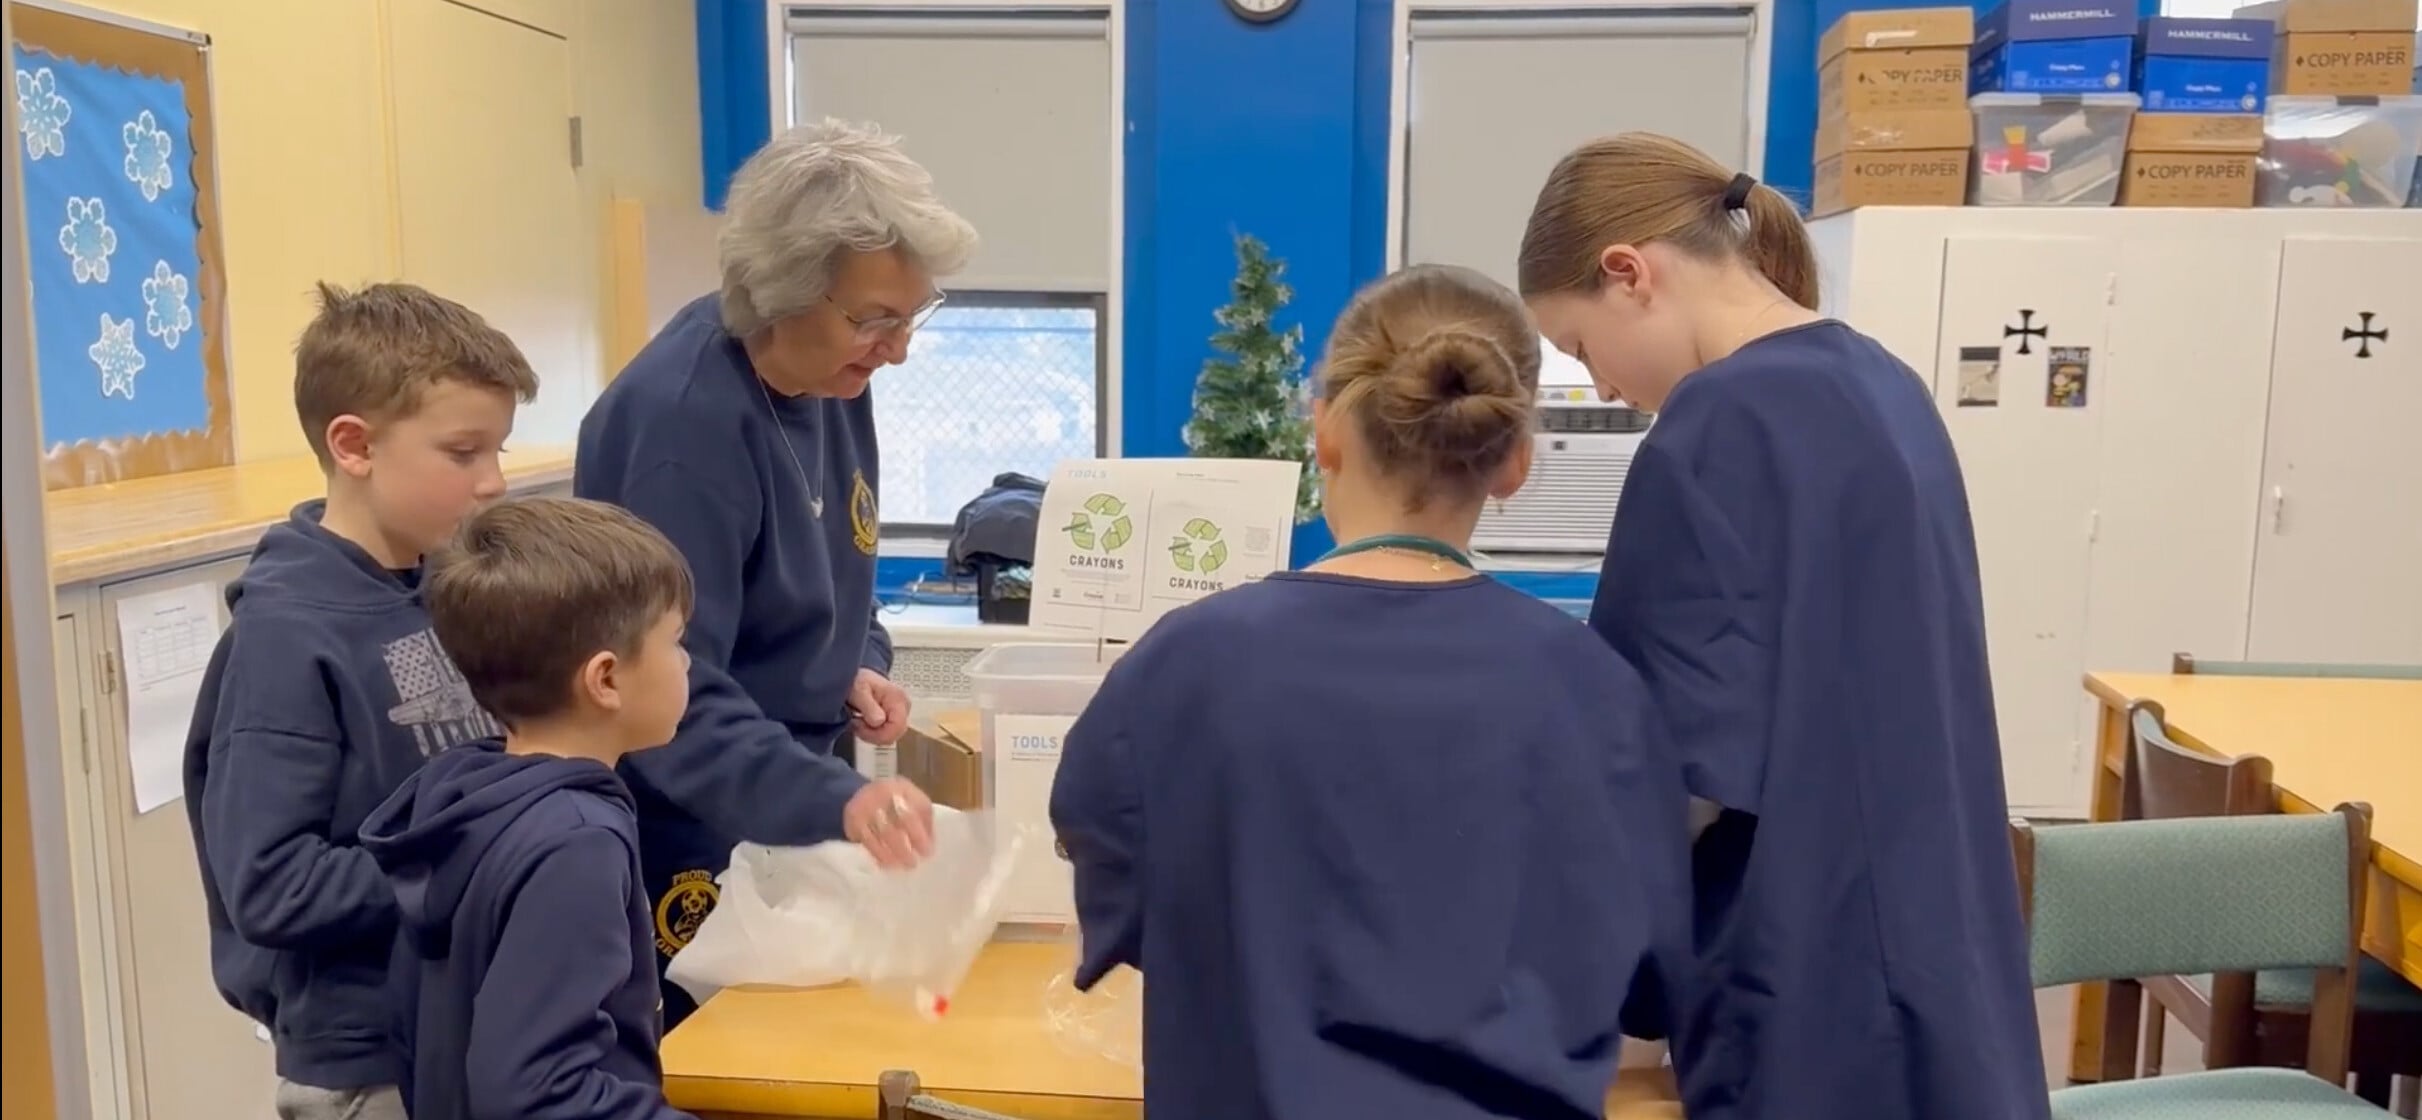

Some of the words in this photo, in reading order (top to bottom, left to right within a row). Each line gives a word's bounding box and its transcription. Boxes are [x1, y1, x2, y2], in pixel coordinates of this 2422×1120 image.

[2029, 9, 2113, 22] HAMMERMILL
[2167, 29, 2251, 42] HAMMERMILL
[2307, 52, 2351, 68] COPY
[2355, 50, 2406, 66] PAPER
[1864, 162, 1907, 177] COPY
[1910, 162, 1959, 177] PAPER
[2148, 165, 2192, 179] COPY
[2195, 164, 2247, 179] PAPER
[1067, 469, 1107, 479] TOOLS
[1069, 554, 1125, 570] CRAYONS
[1168, 576, 1224, 592] CRAYONS
[1011, 735, 1059, 749] TOOLS
